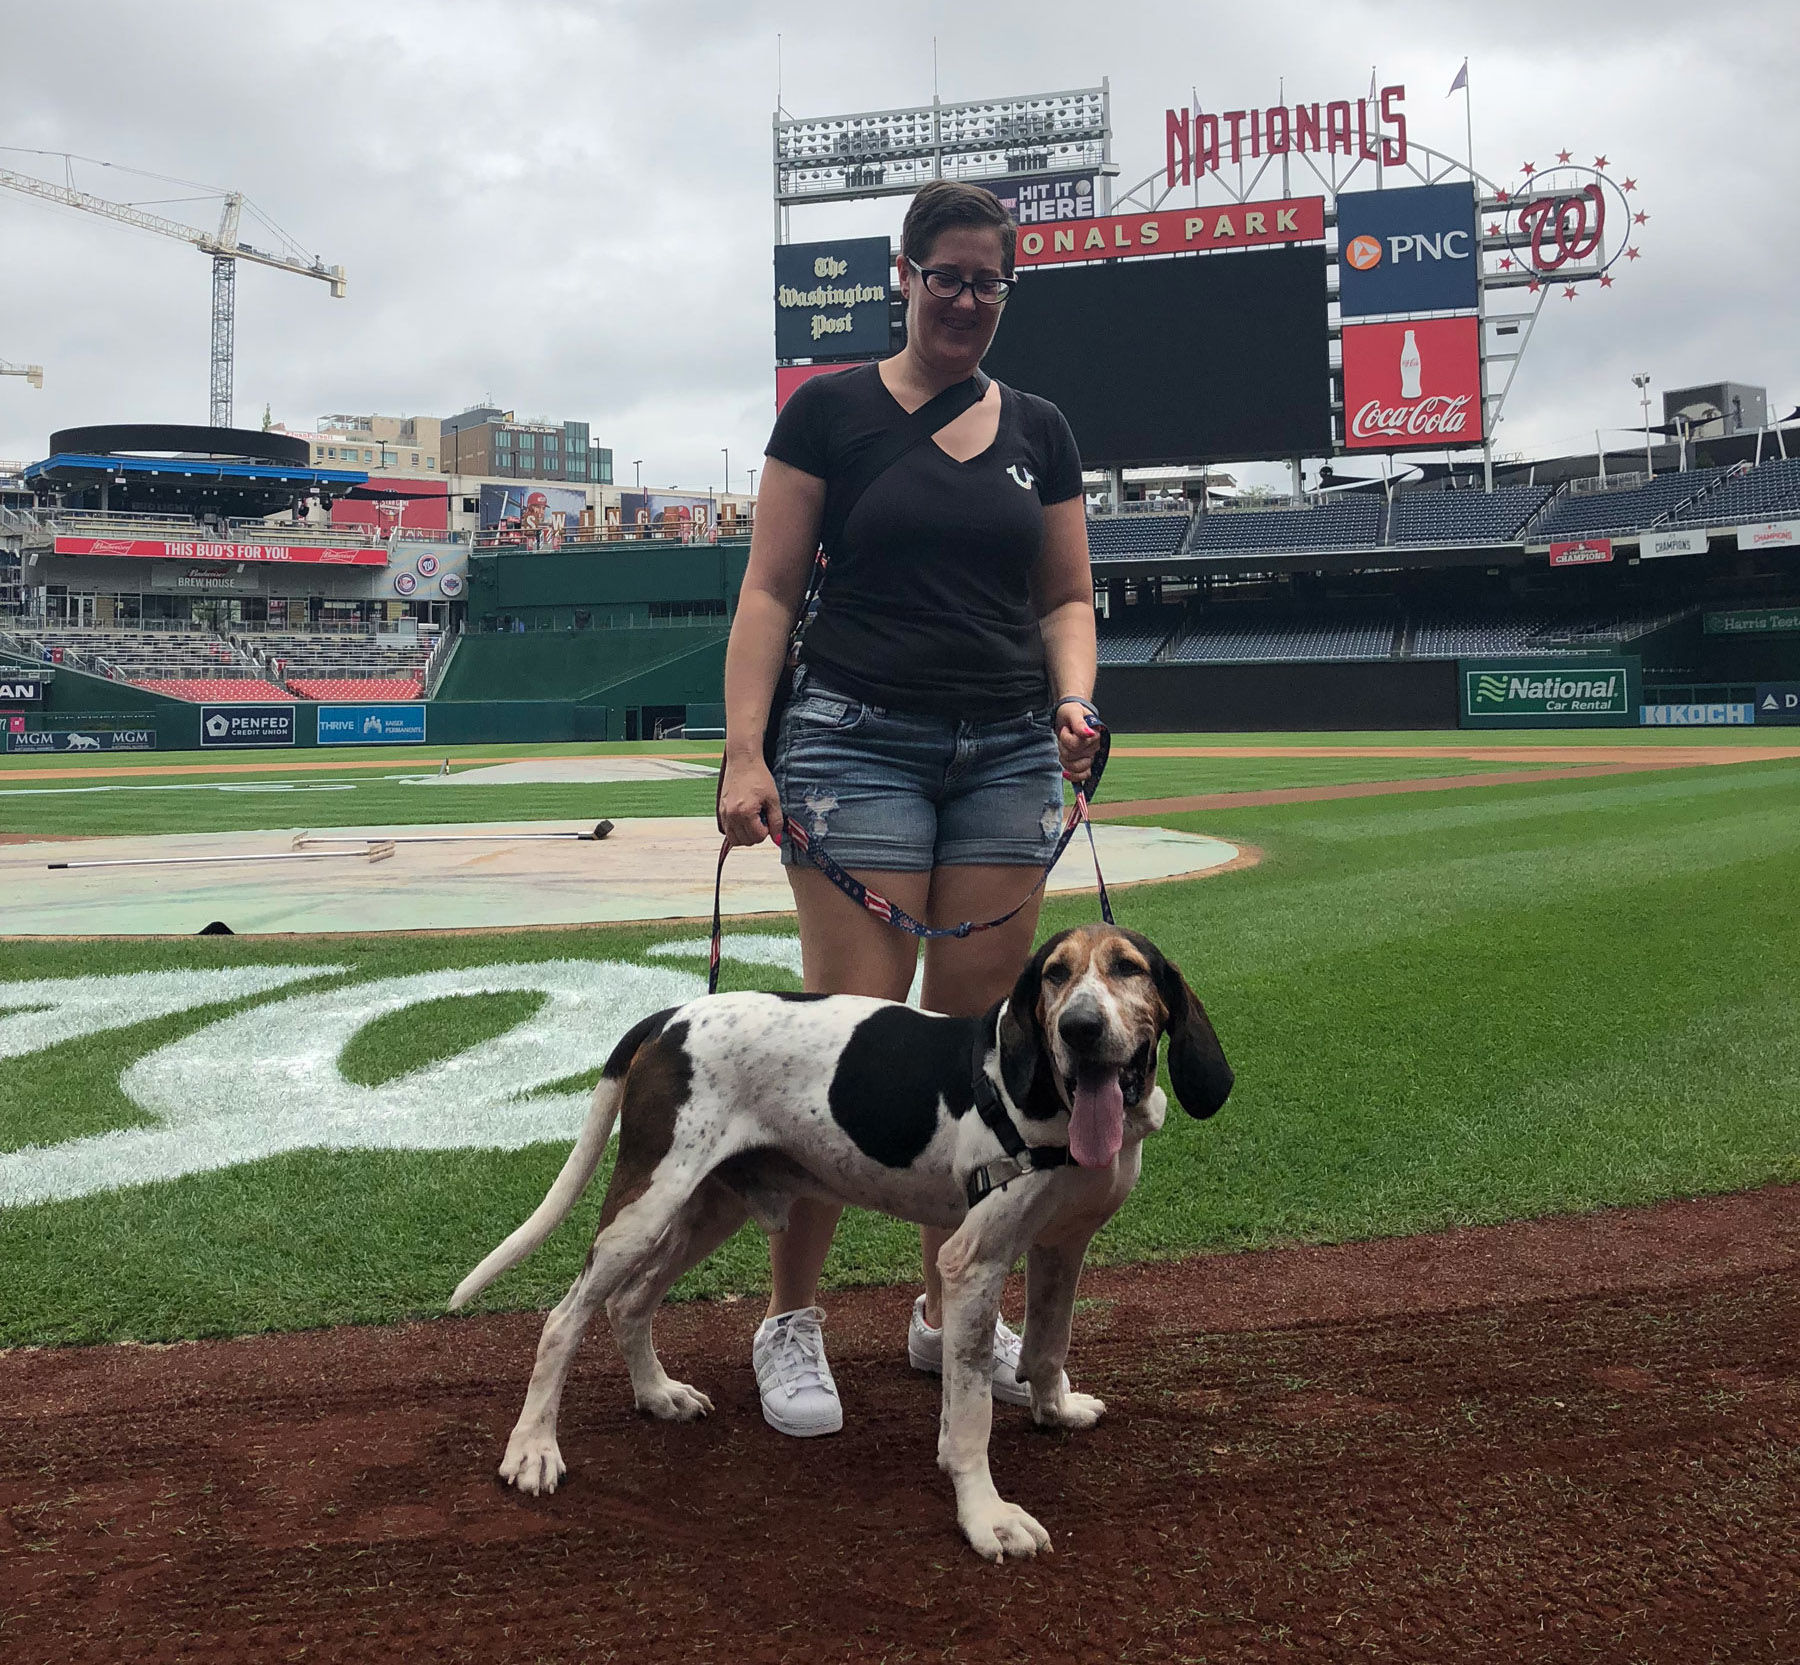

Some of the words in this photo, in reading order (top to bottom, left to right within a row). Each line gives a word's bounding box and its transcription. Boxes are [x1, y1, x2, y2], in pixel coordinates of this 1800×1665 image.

[1166, 85, 1407, 187] NATIONALS
[1019, 184, 1050, 201] HIT
[1055, 182, 1072, 197] IT
[1019, 196, 1093, 222] HERE
[1022, 221, 1160, 255] ONALS
[1185, 208, 1298, 240] PARK
[1518, 184, 1605, 271] W
[1387, 230, 1470, 264] PNC
[814, 256, 848, 279] The
[778, 283, 885, 308] Washington
[811, 312, 853, 340] Post
[1352, 394, 1473, 438] Coca-Cola
[164, 542, 193, 557] THIS
[196, 544, 235, 558] BUD'S
[238, 545, 261, 559] FOR
[264, 546, 292, 560] YOU.
[1556, 551, 1606, 563] CHAMPIONS
[178, 577, 203, 588] BREW
[206, 578, 235, 588] HOUSE
[1724, 617, 1767, 630] Harris
[1769, 615, 1800, 628] Teet
[1546, 701, 1566, 710] Car
[1571, 700, 1611, 710] Rental
[232, 717, 289, 728] PENFED
[320, 721, 354, 730] THRIVE
[16, 733, 54, 744] MGM
[112, 732, 149, 743] MGM
